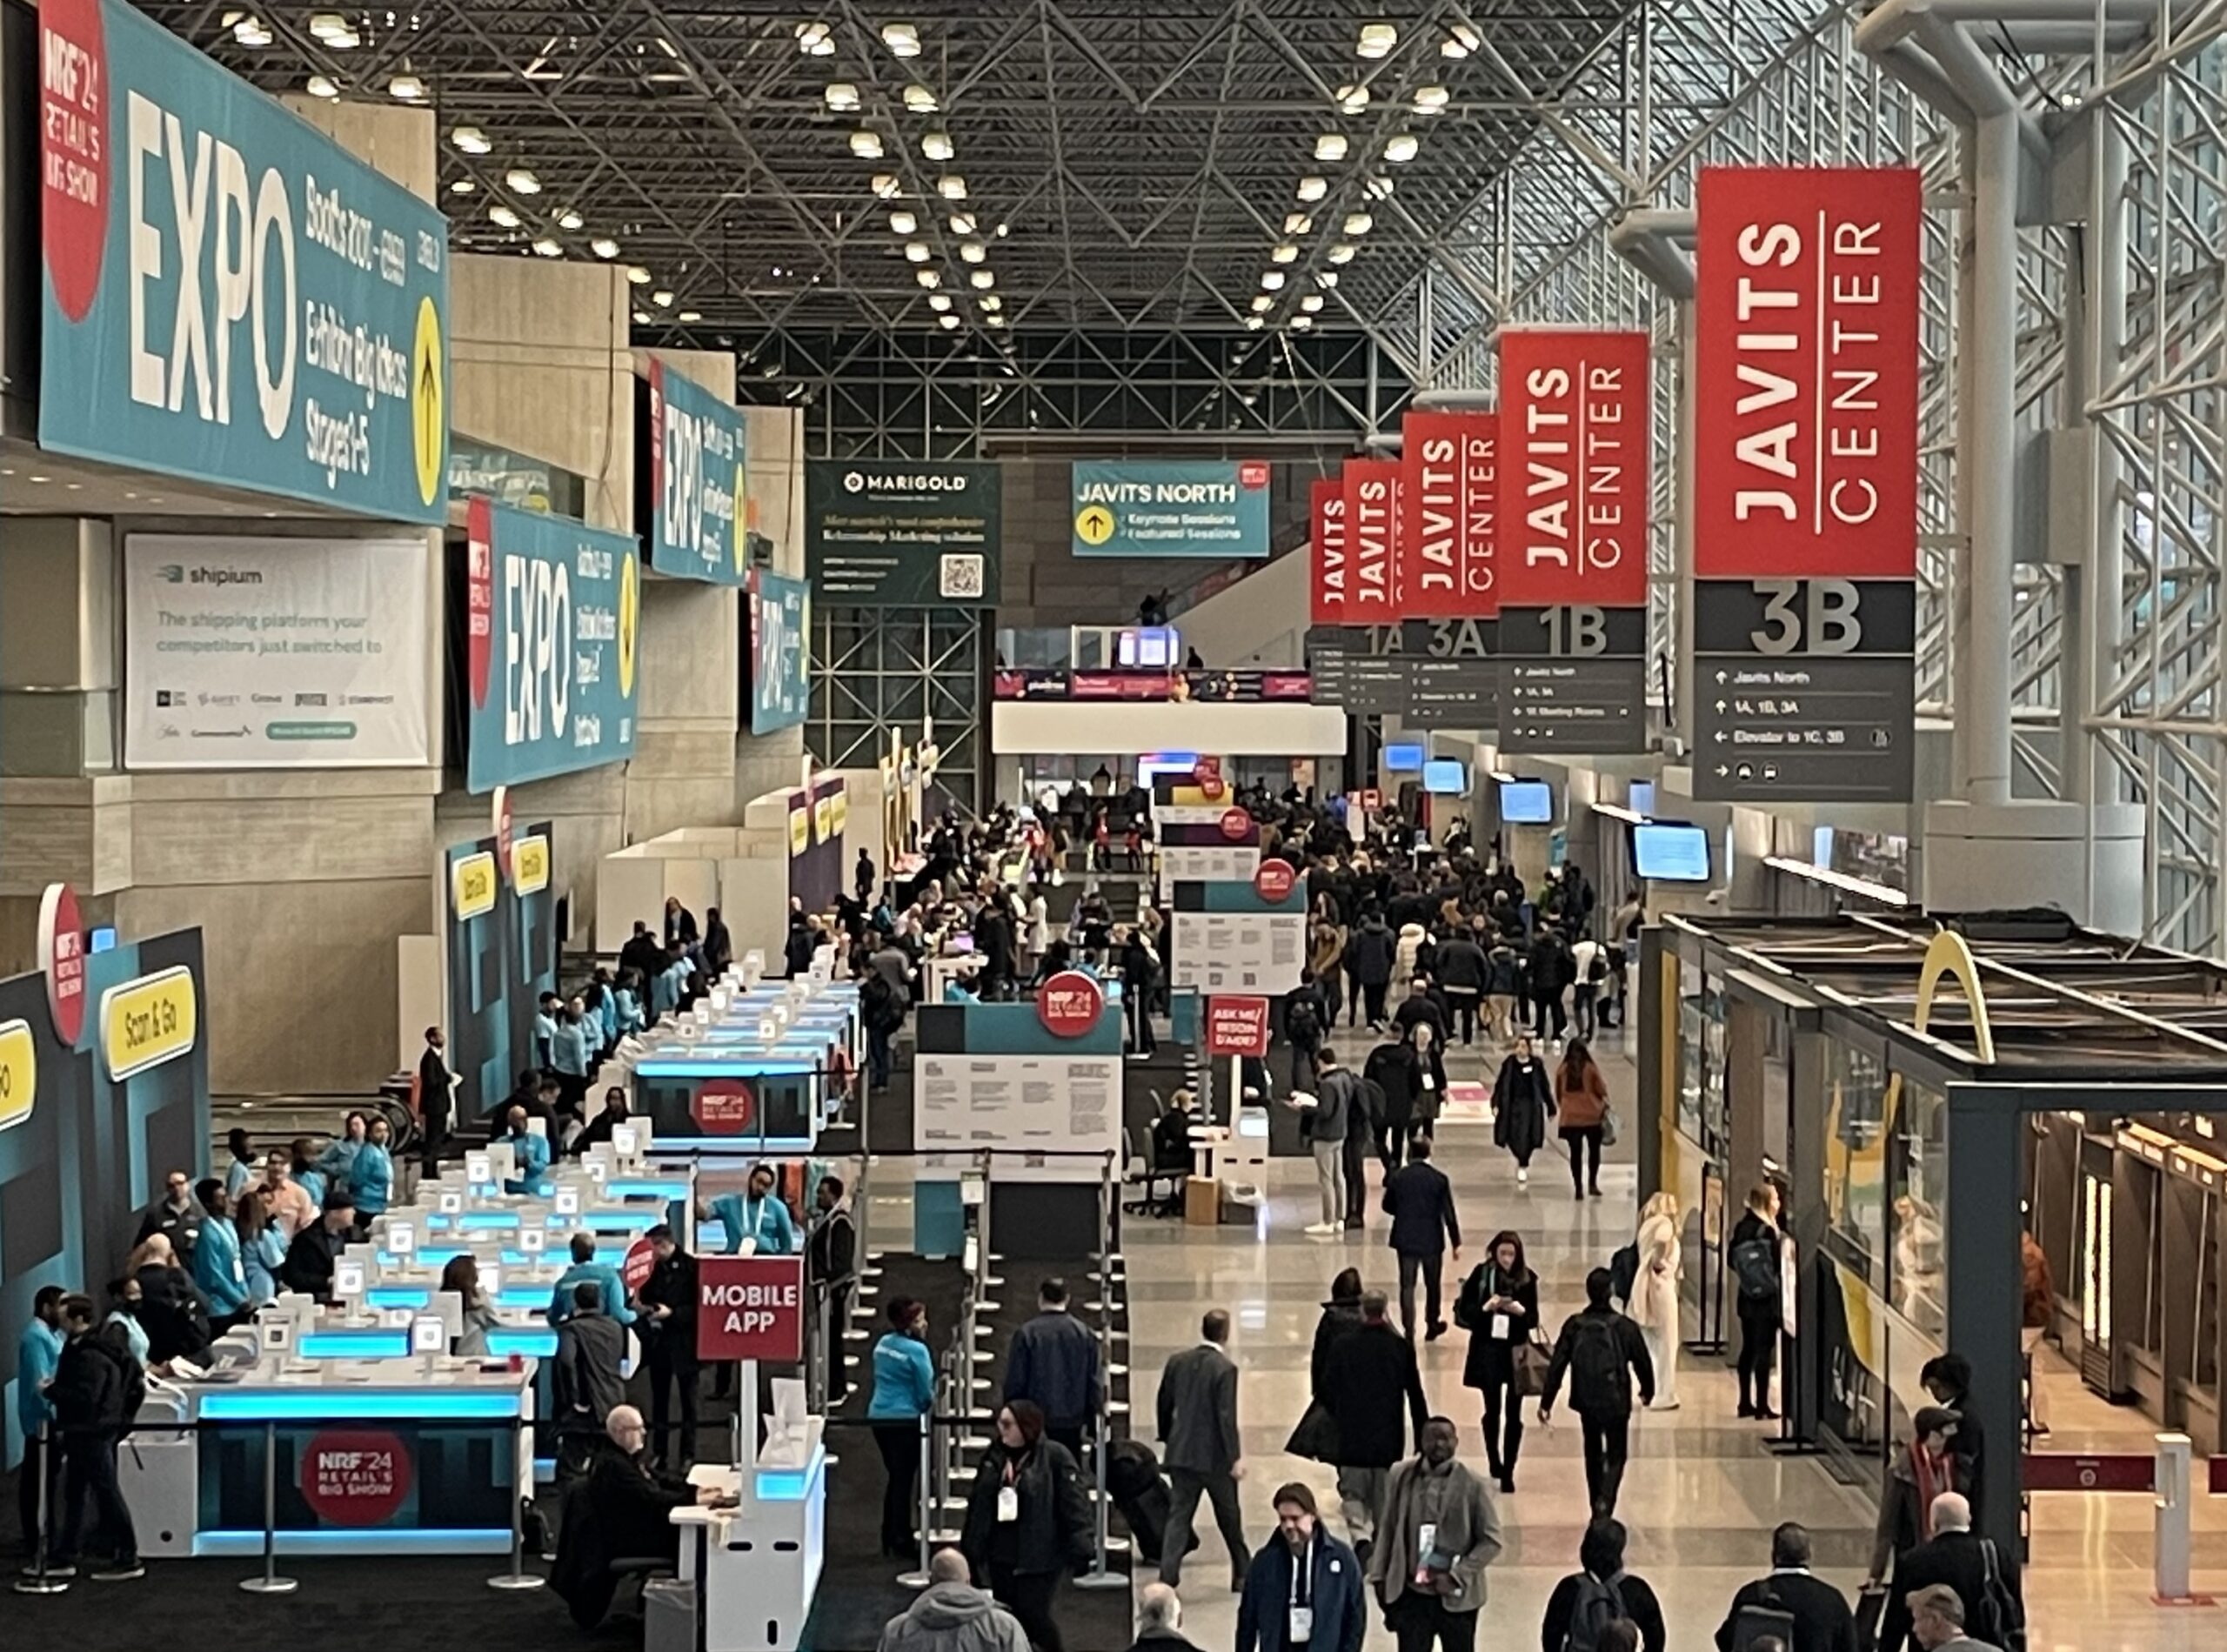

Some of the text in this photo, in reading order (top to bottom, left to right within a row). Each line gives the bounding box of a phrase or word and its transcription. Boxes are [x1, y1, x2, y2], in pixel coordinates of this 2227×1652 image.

[44, 27, 78, 102] NRF
[128, 89, 296, 440] EXPO
[354, 323, 376, 410] Big
[1735, 221, 1802, 522] JAVITS
[1829, 221, 1882, 525] CENTER
[665, 403, 703, 552] EXPO
[867, 474, 966, 492] MARIGOLD
[1076, 482, 1237, 504] JAVITS NORTH
[1527, 367, 1570, 567] JAVITS
[1588, 366, 1622, 569] CENTER
[1421, 438, 1455, 590] JAVITS
[1468, 438, 1495, 592] CENTER
[1323, 498, 1345, 605] JAVITS
[1359, 480, 1387, 604] JAVITS
[190, 566, 263, 587] shipium
[157, 611, 186, 627] The
[191, 612, 258, 631] shipping
[333, 617, 368, 632] your
[1364, 625, 1403, 655] 1A
[1426, 619, 1487, 657] 3A
[1539, 605, 1608, 657] 1B
[1750, 580, 1862, 655] 3B
[156, 639, 383, 656] competitors just switched to
[505, 553, 571, 745] EXPO
[1774, 672, 1810, 685] North
[1733, 730, 1783, 744] Elevator
[1788, 731, 1801, 744] to
[125, 1011, 151, 1050] Scan
[162, 997, 177, 1035] Go
[702, 1285, 798, 1307] MOBILE
[723, 1310, 776, 1334] APP
[318, 1451, 363, 1470] NRF
[318, 1470, 393, 1483] RETAIL'S
[318, 1482, 393, 1495] BIG SHOW
